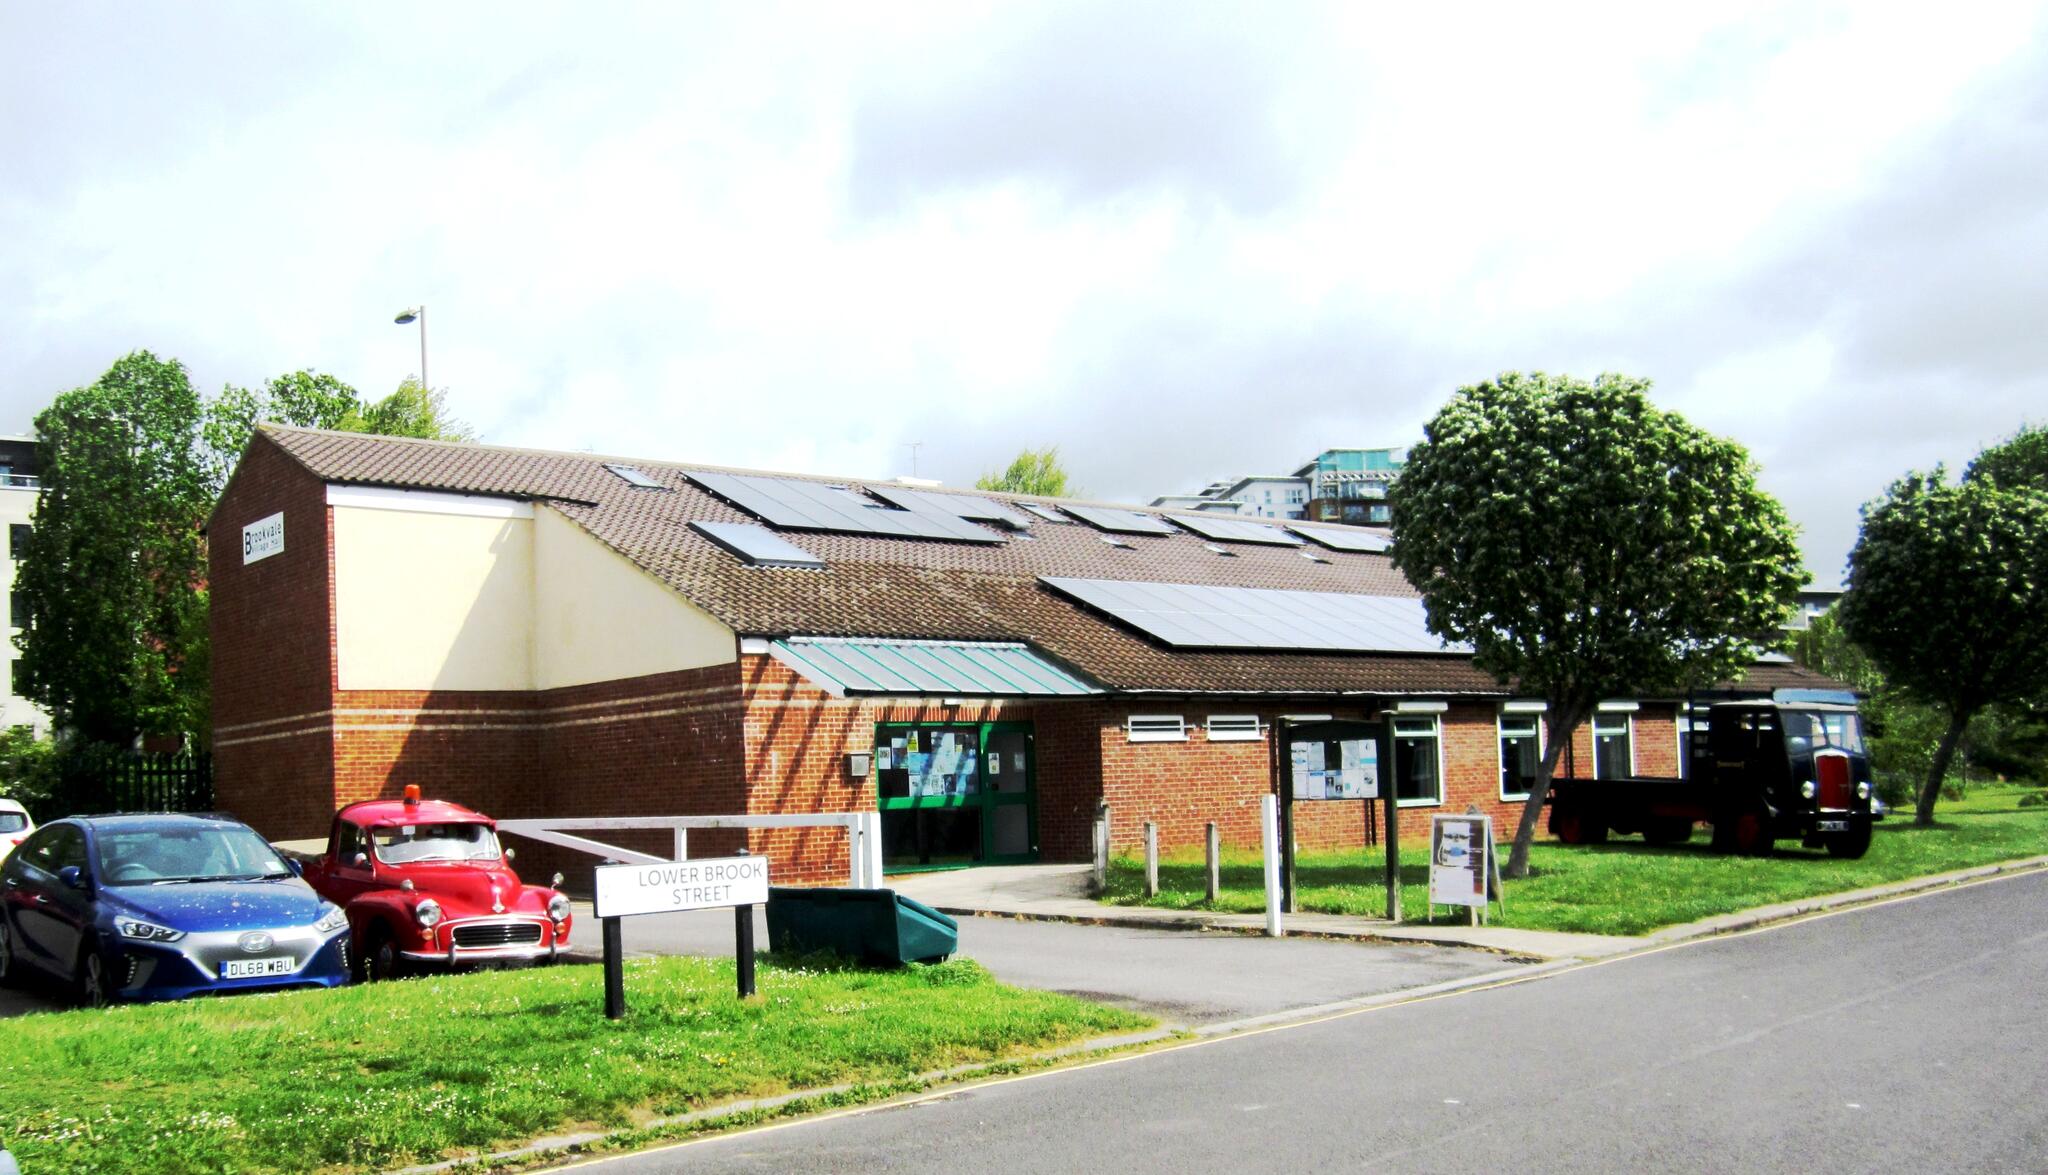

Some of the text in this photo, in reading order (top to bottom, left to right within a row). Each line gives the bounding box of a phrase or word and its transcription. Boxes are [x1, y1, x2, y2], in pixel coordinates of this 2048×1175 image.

[245, 521, 281, 555] Brookvale
[639, 863, 762, 887] LOWER BROOK
[673, 885, 732, 904] STREET
[268, 959, 291, 972] WBU
